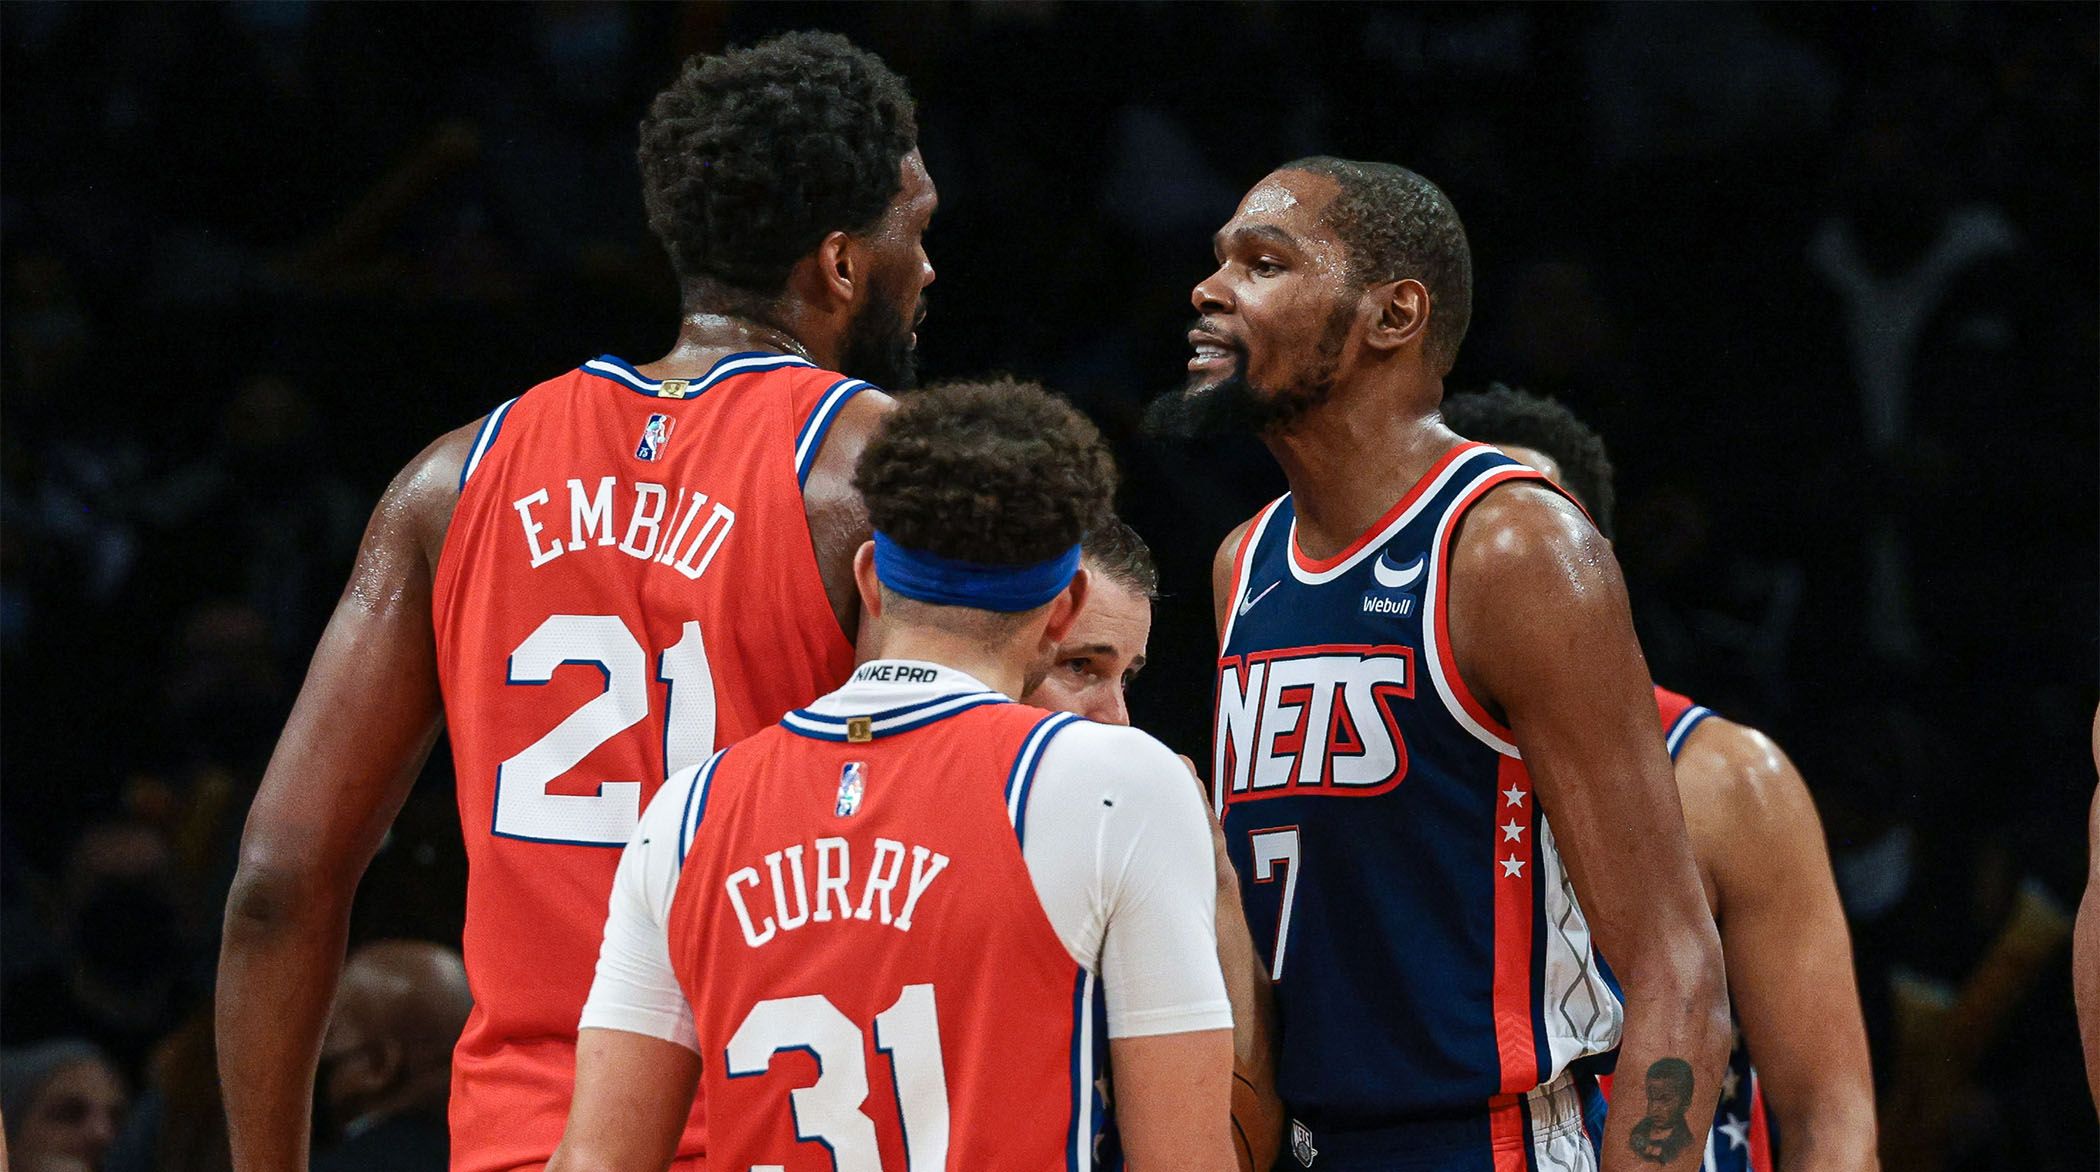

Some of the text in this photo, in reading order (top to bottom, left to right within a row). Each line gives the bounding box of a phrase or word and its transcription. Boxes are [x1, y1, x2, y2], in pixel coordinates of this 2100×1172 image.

[853, 665, 938, 683] NIKE PRO
[1363, 596, 1411, 615] Webull
[491, 614, 717, 847] 21
[1213, 645, 1414, 822] NETS
[725, 837, 950, 948] CURRY
[1248, 824, 1301, 983] 7
[725, 983, 950, 1172] 31
